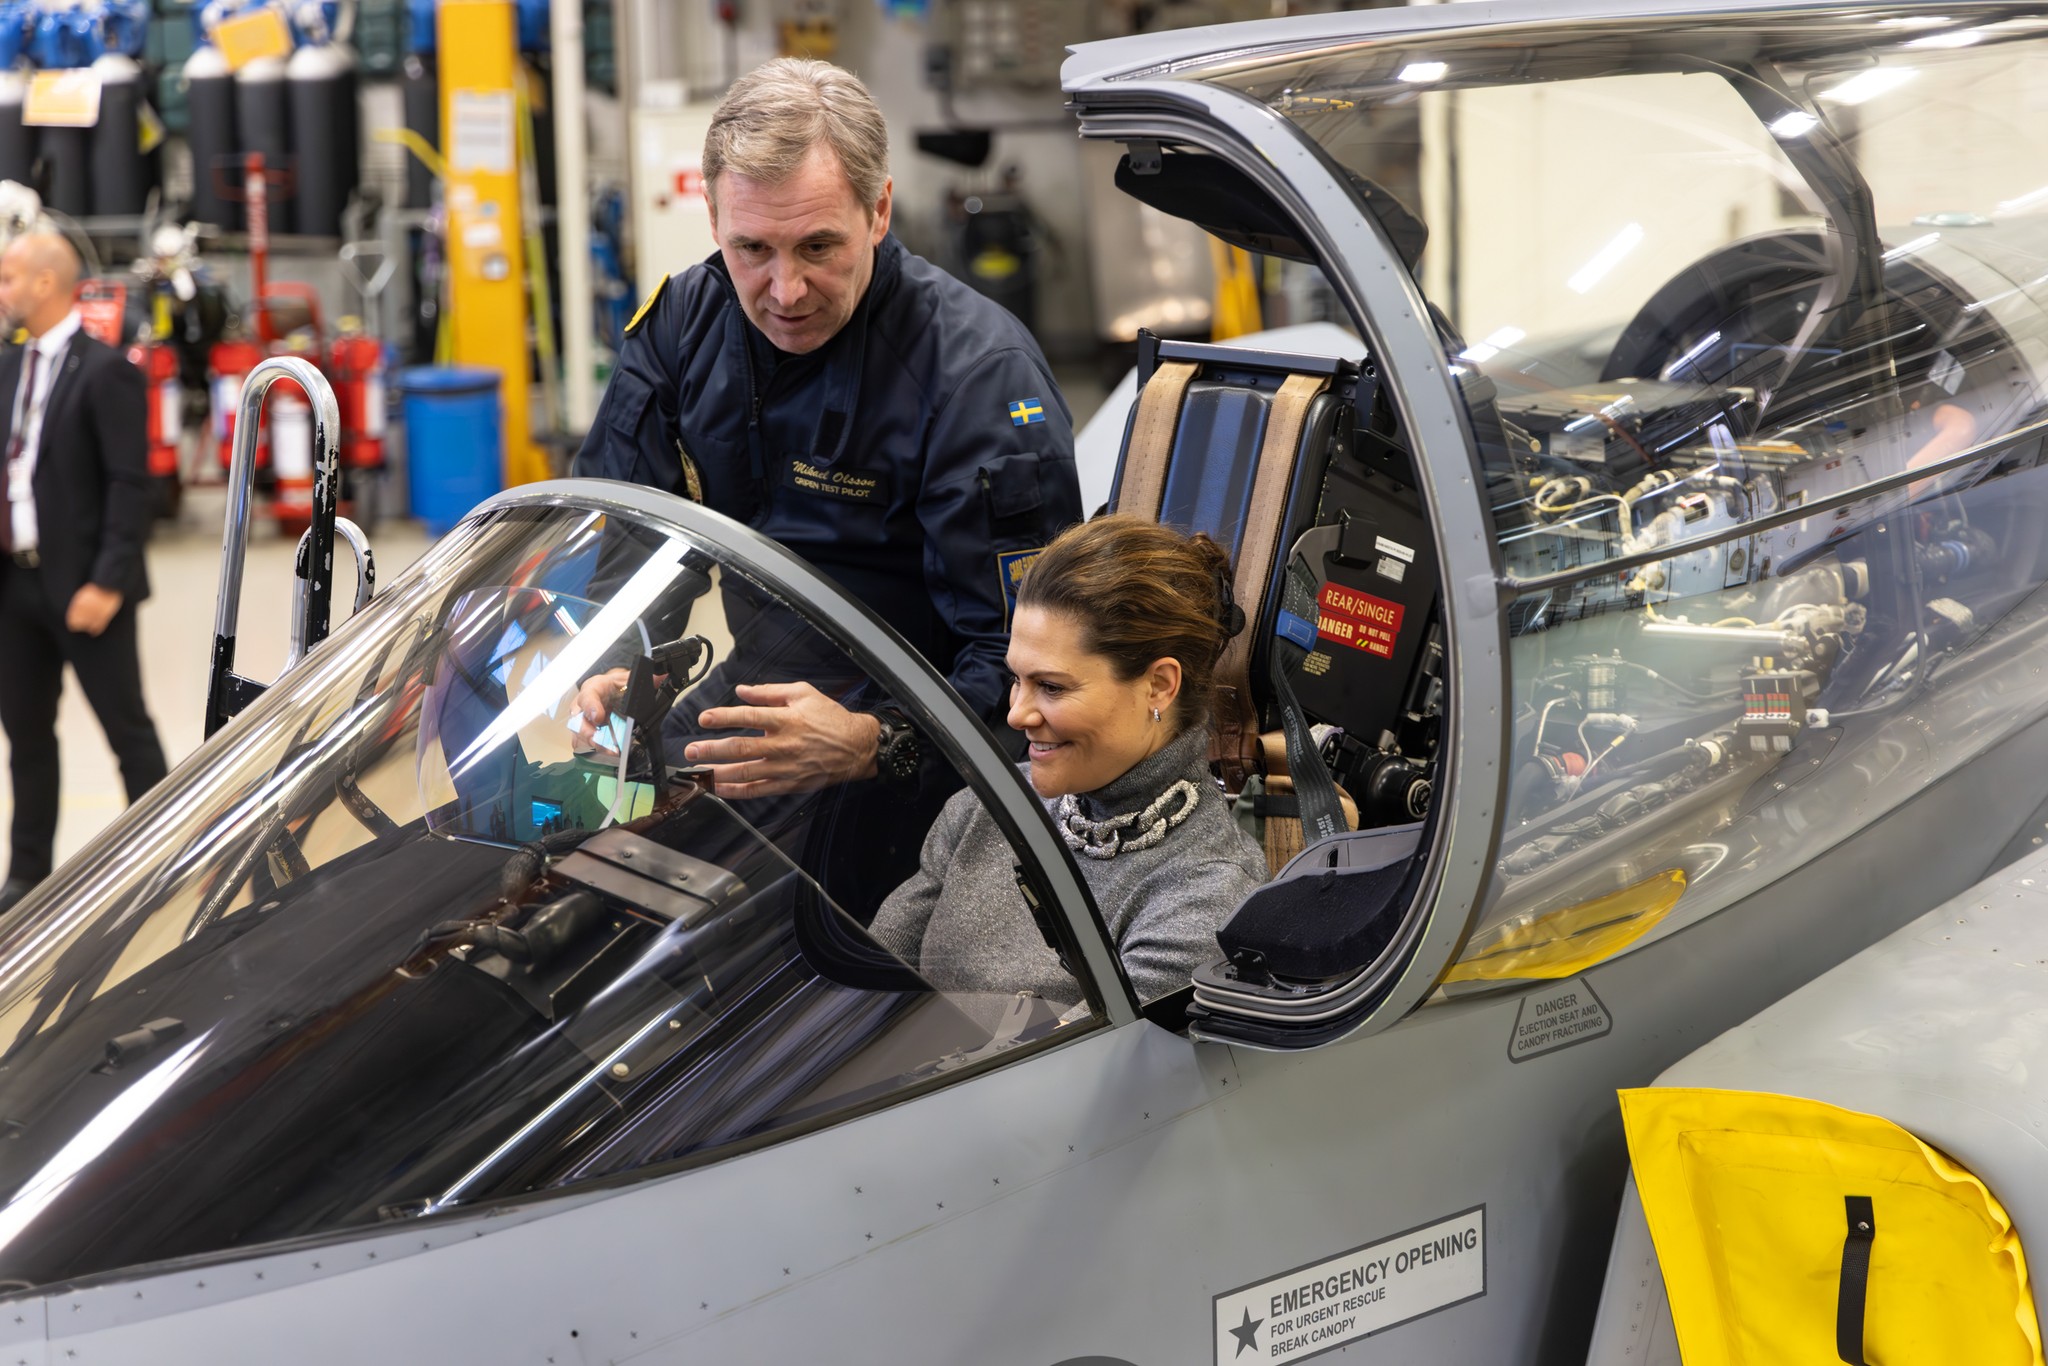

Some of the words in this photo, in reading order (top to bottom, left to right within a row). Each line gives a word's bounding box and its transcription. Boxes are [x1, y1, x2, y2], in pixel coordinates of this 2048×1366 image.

[793, 460, 830, 480] Mikael
[832, 472, 876, 487] Olsson
[794, 476, 819, 490] GRIPEN
[820, 483, 840, 494] TEST
[842, 488, 870, 498] PILOT
[1325, 590, 1395, 626] REAR/SINGLE
[1359, 624, 1366, 633] DO
[1368, 628, 1379, 638] NOT
[1380, 631, 1390, 642] PULL
[1369, 642, 1388, 655] HANDLE
[1519, 1016, 1558, 1036] EJECTION
[1559, 1010, 1579, 1024] SEAT
[1582, 1004, 1598, 1016] AND
[1536, 994, 1578, 1016] DANGER
[1518, 1032, 1551, 1050] CANOPY
[1552, 1016, 1602, 1040] FRACTURING
[1270, 1257, 1390, 1318] EMERGENCY
[1395, 1228, 1477, 1274] OPENING
[1271, 1320, 1294, 1338] FOR
[1296, 1302, 1340, 1329] URGENT
[1343, 1286, 1386, 1314] RESCUE
[1271, 1332, 1308, 1357] BREAK
[1311, 1316, 1356, 1342] CANOPY
